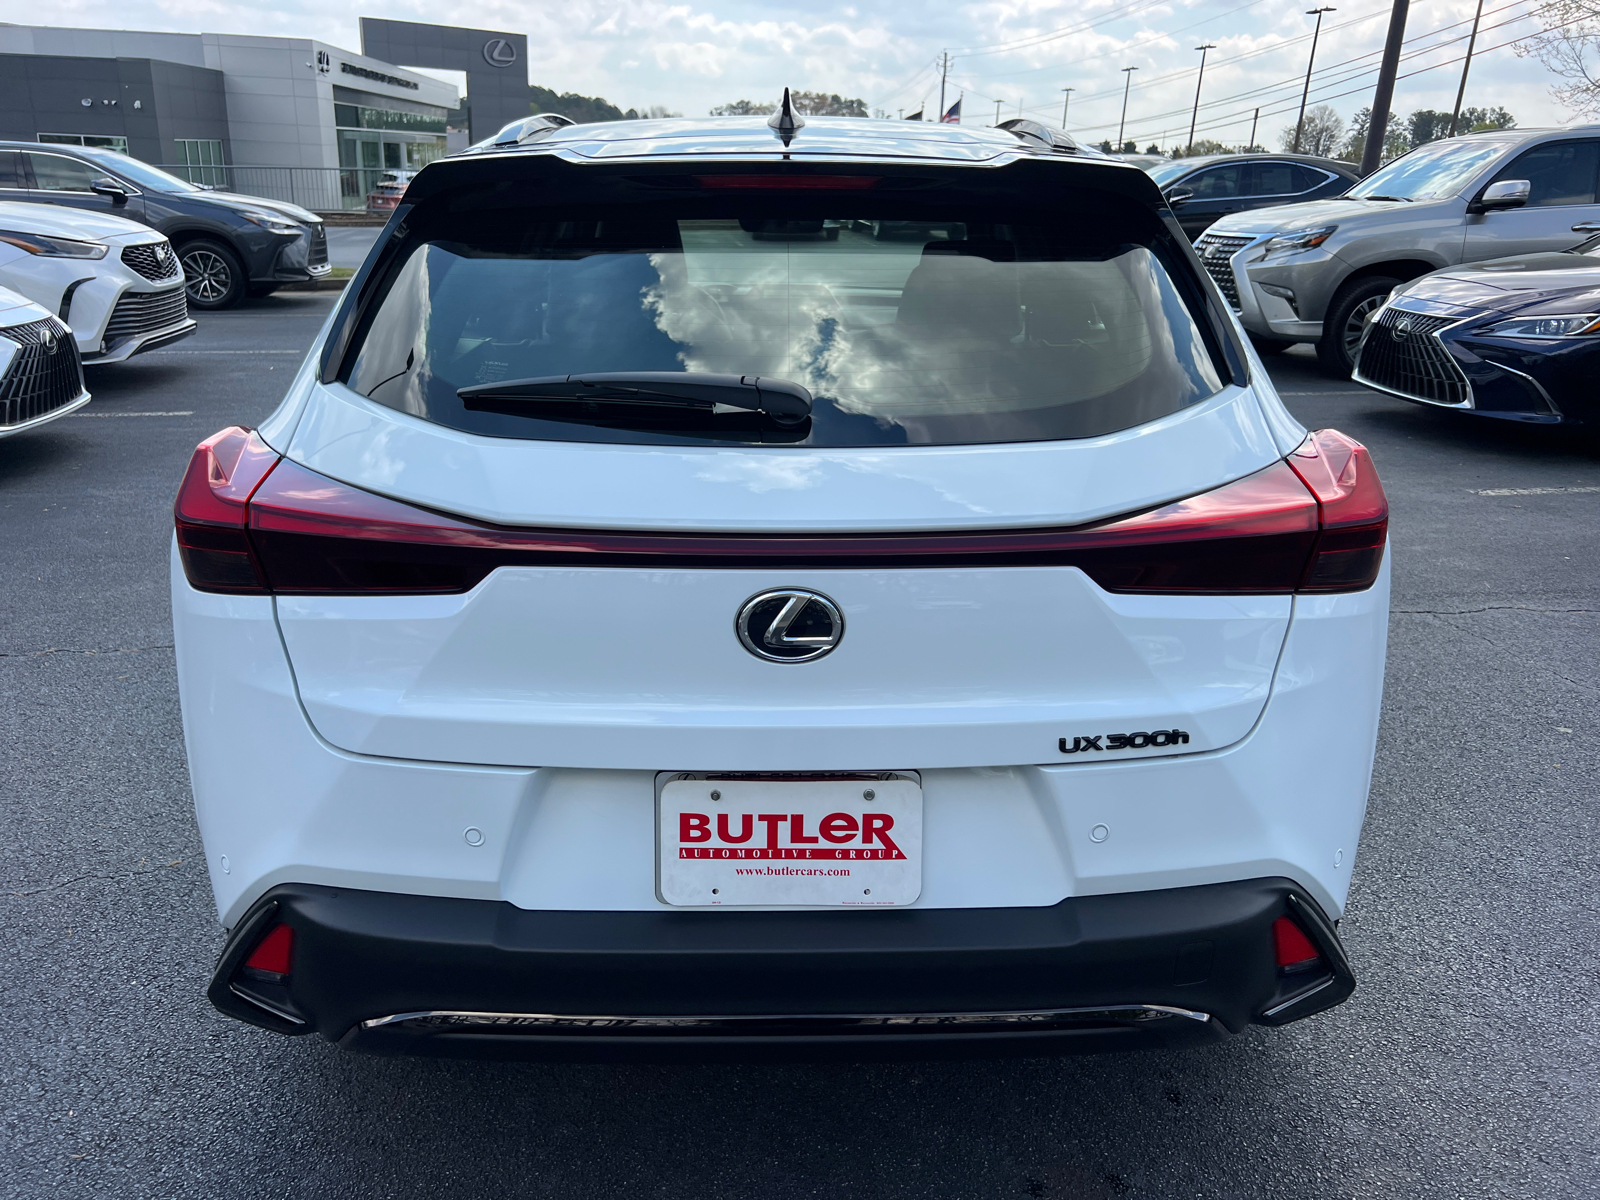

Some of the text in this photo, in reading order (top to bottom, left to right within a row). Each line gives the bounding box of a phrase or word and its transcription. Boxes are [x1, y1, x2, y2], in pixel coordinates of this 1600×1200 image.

[680, 848, 900, 860] AUTOMOTIVE GROUP
[735, 866, 851, 877] www.butlercars.com
